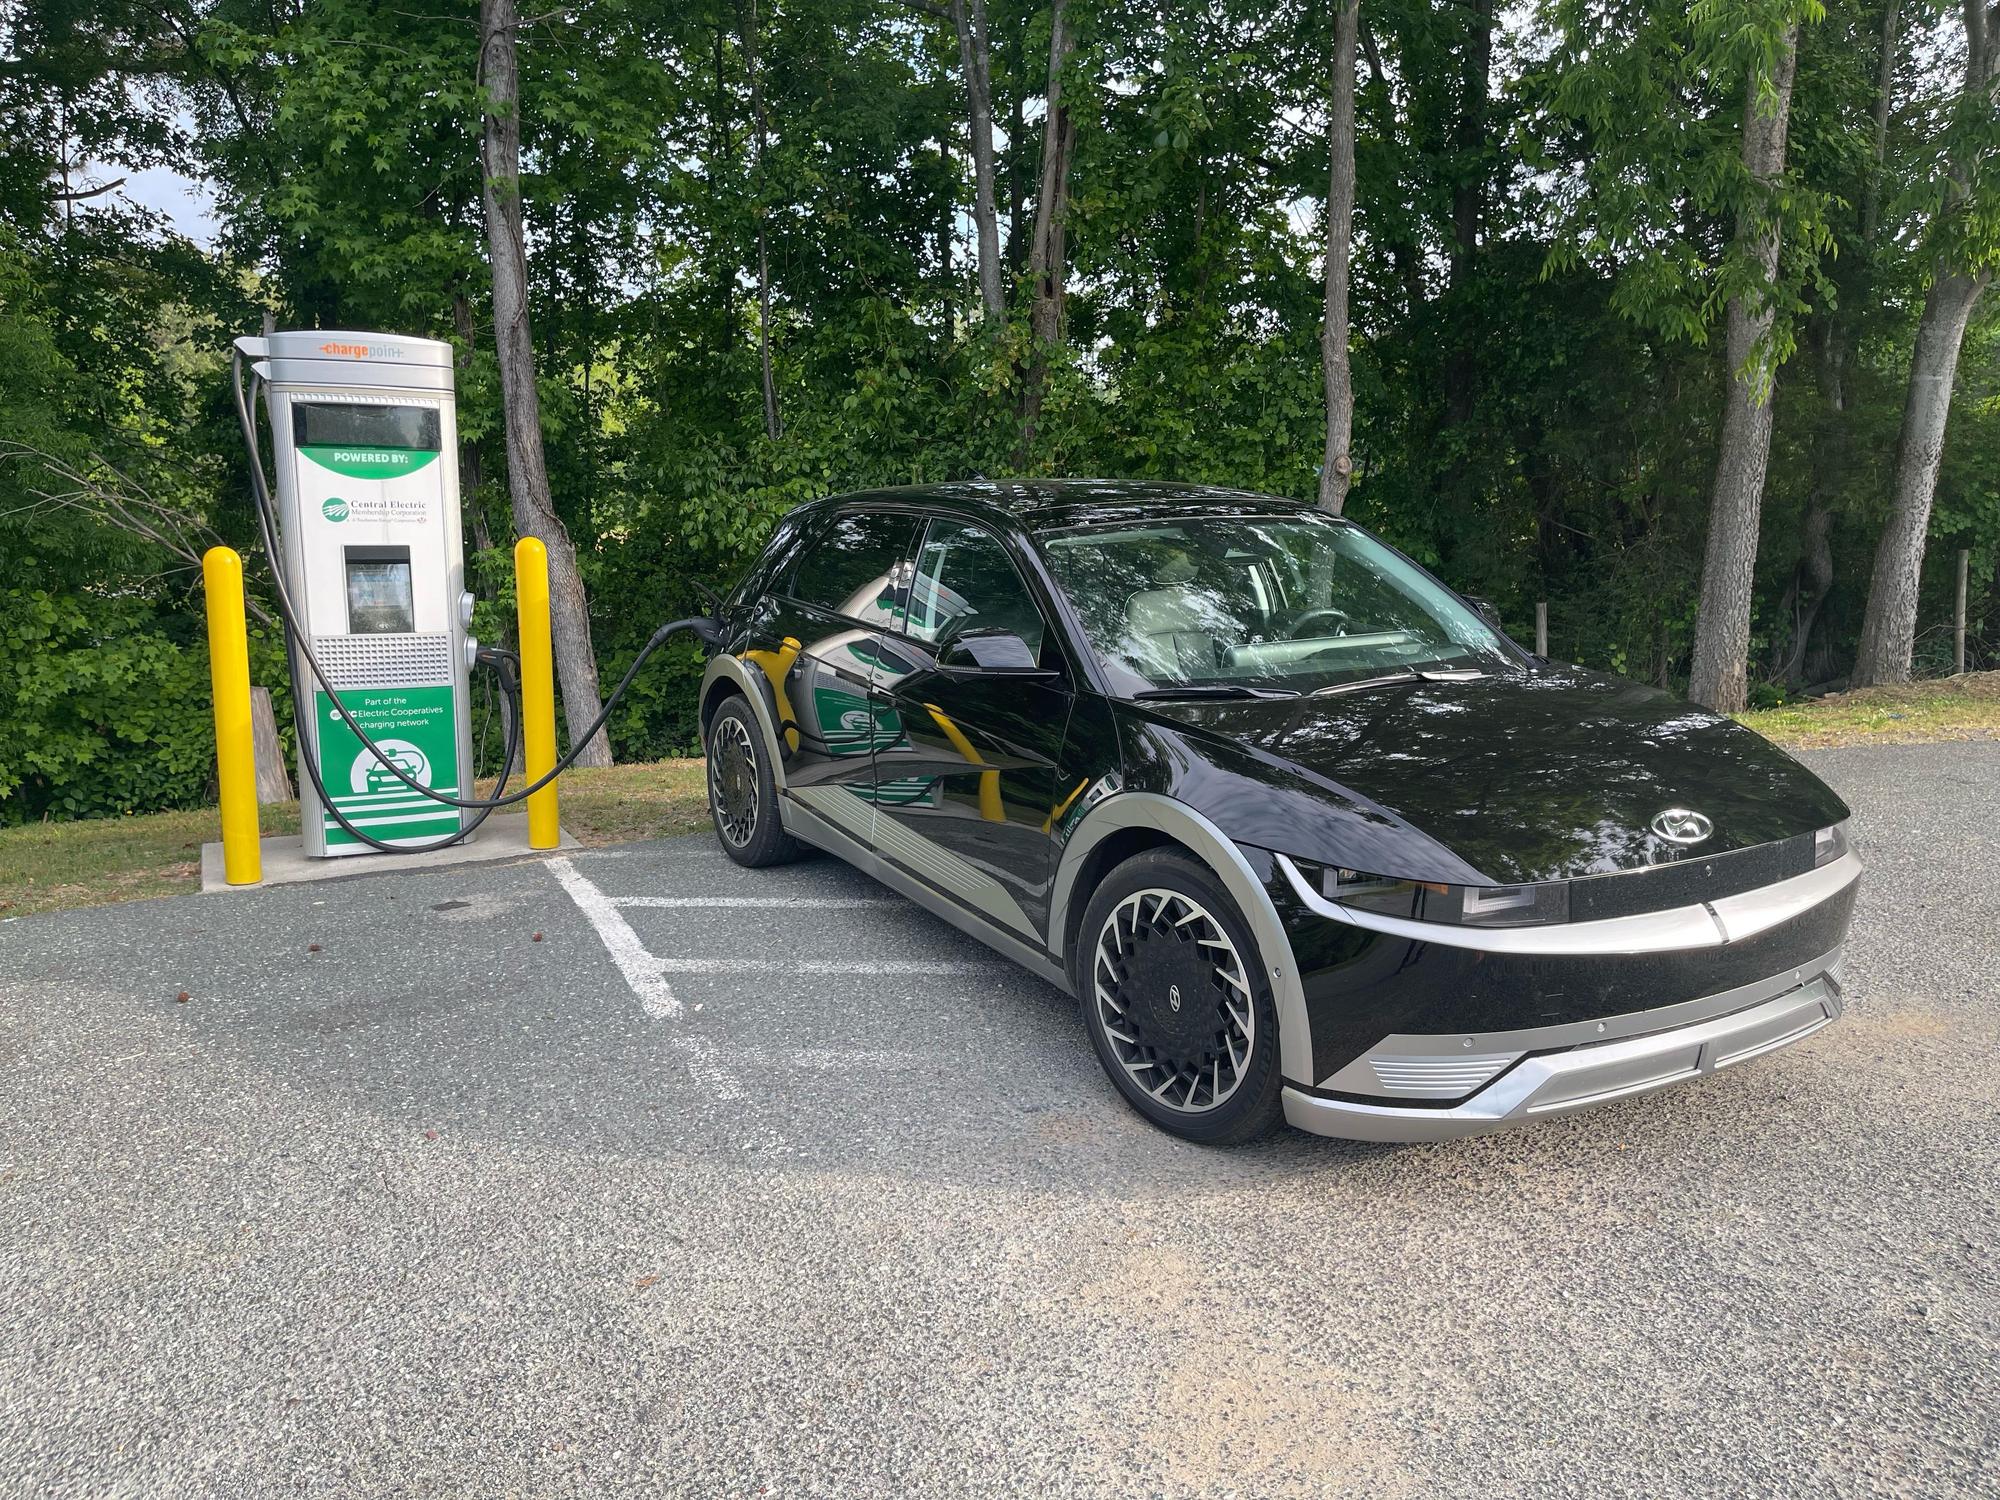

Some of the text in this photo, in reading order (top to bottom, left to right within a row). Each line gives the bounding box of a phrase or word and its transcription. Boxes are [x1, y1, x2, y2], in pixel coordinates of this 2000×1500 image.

[334, 452, 409, 463] POWERED BY:
[351, 500, 426, 509] Central Electric
[351, 508, 427, 517] Membership Corporation
[365, 698, 381, 706] Part
[358, 709, 389, 718] Electric
[391, 706, 444, 716] Cooperatives
[359, 721, 395, 729] charging
